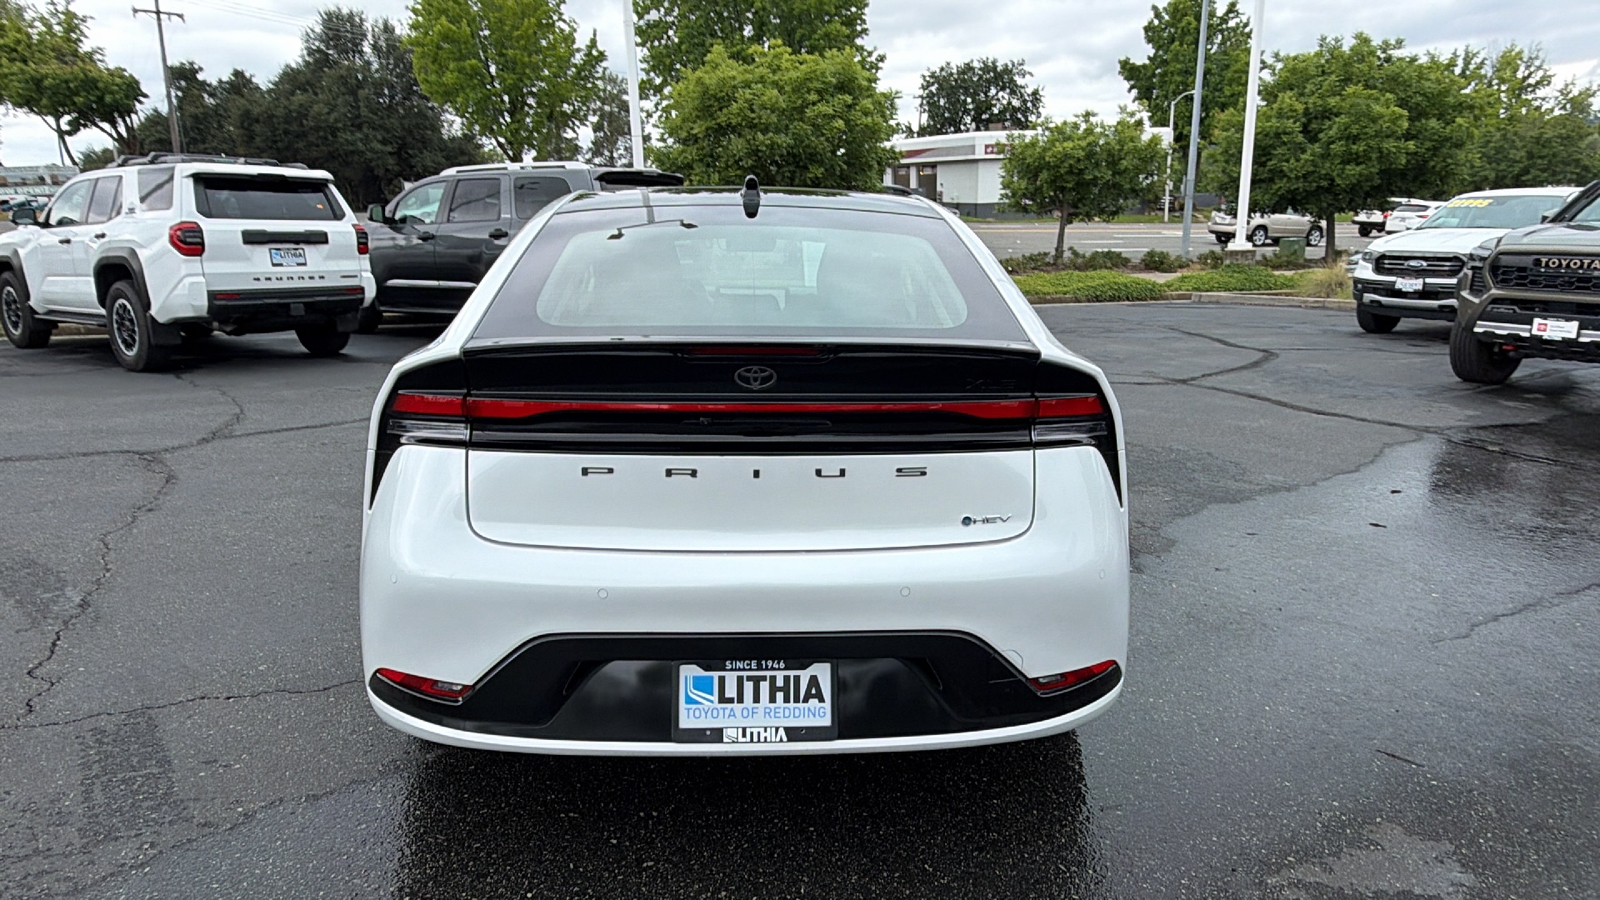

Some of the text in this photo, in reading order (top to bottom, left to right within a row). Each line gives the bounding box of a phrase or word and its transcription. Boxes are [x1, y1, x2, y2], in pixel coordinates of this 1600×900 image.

[1540, 258, 1600, 269] TOYOTA
[581, 466, 928, 478] PRIUS
[725, 660, 785, 669] SINCE 1946
[718, 675, 825, 704] LITHIA
[685, 706, 826, 719] TOYOTA OF REDDING
[738, 727, 788, 742] LITHIA
